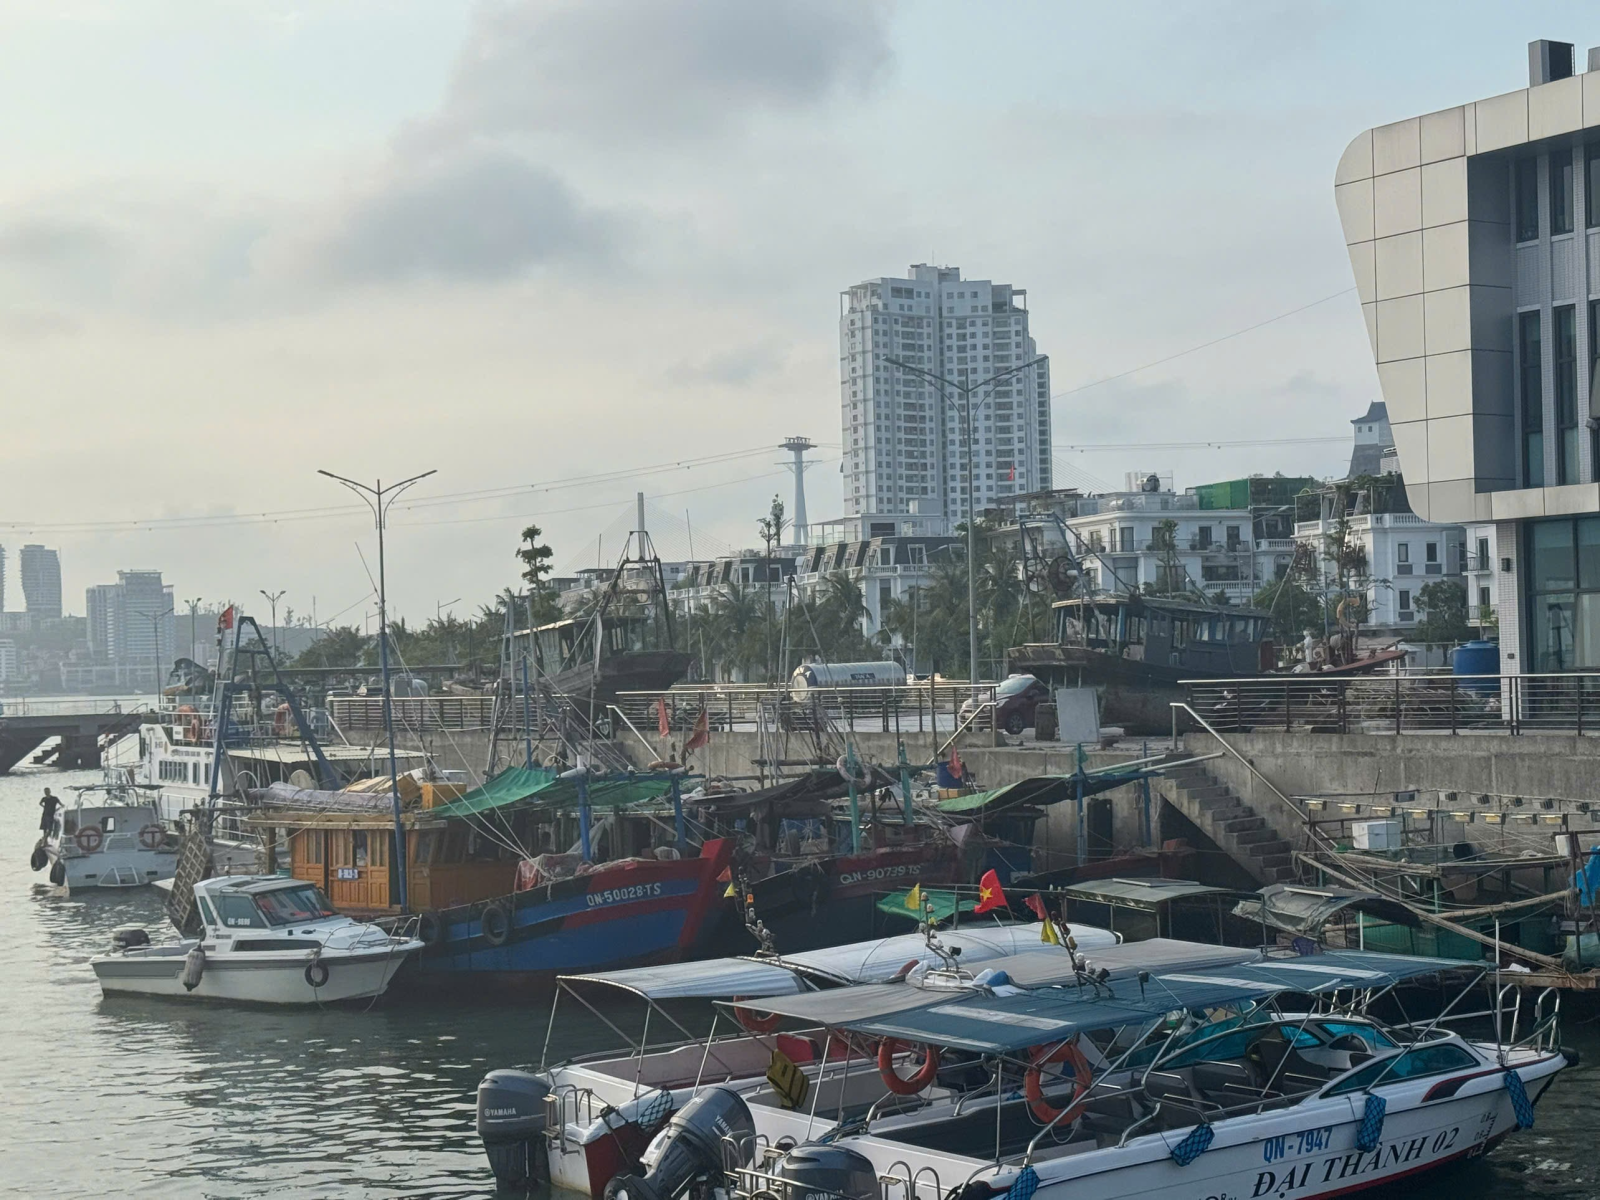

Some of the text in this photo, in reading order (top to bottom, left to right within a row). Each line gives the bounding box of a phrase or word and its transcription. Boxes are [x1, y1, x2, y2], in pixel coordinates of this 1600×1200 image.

[490, 1107, 517, 1117] YAMAHA
[1250, 1127, 1460, 1200] ĐẠI THÀNH 02
